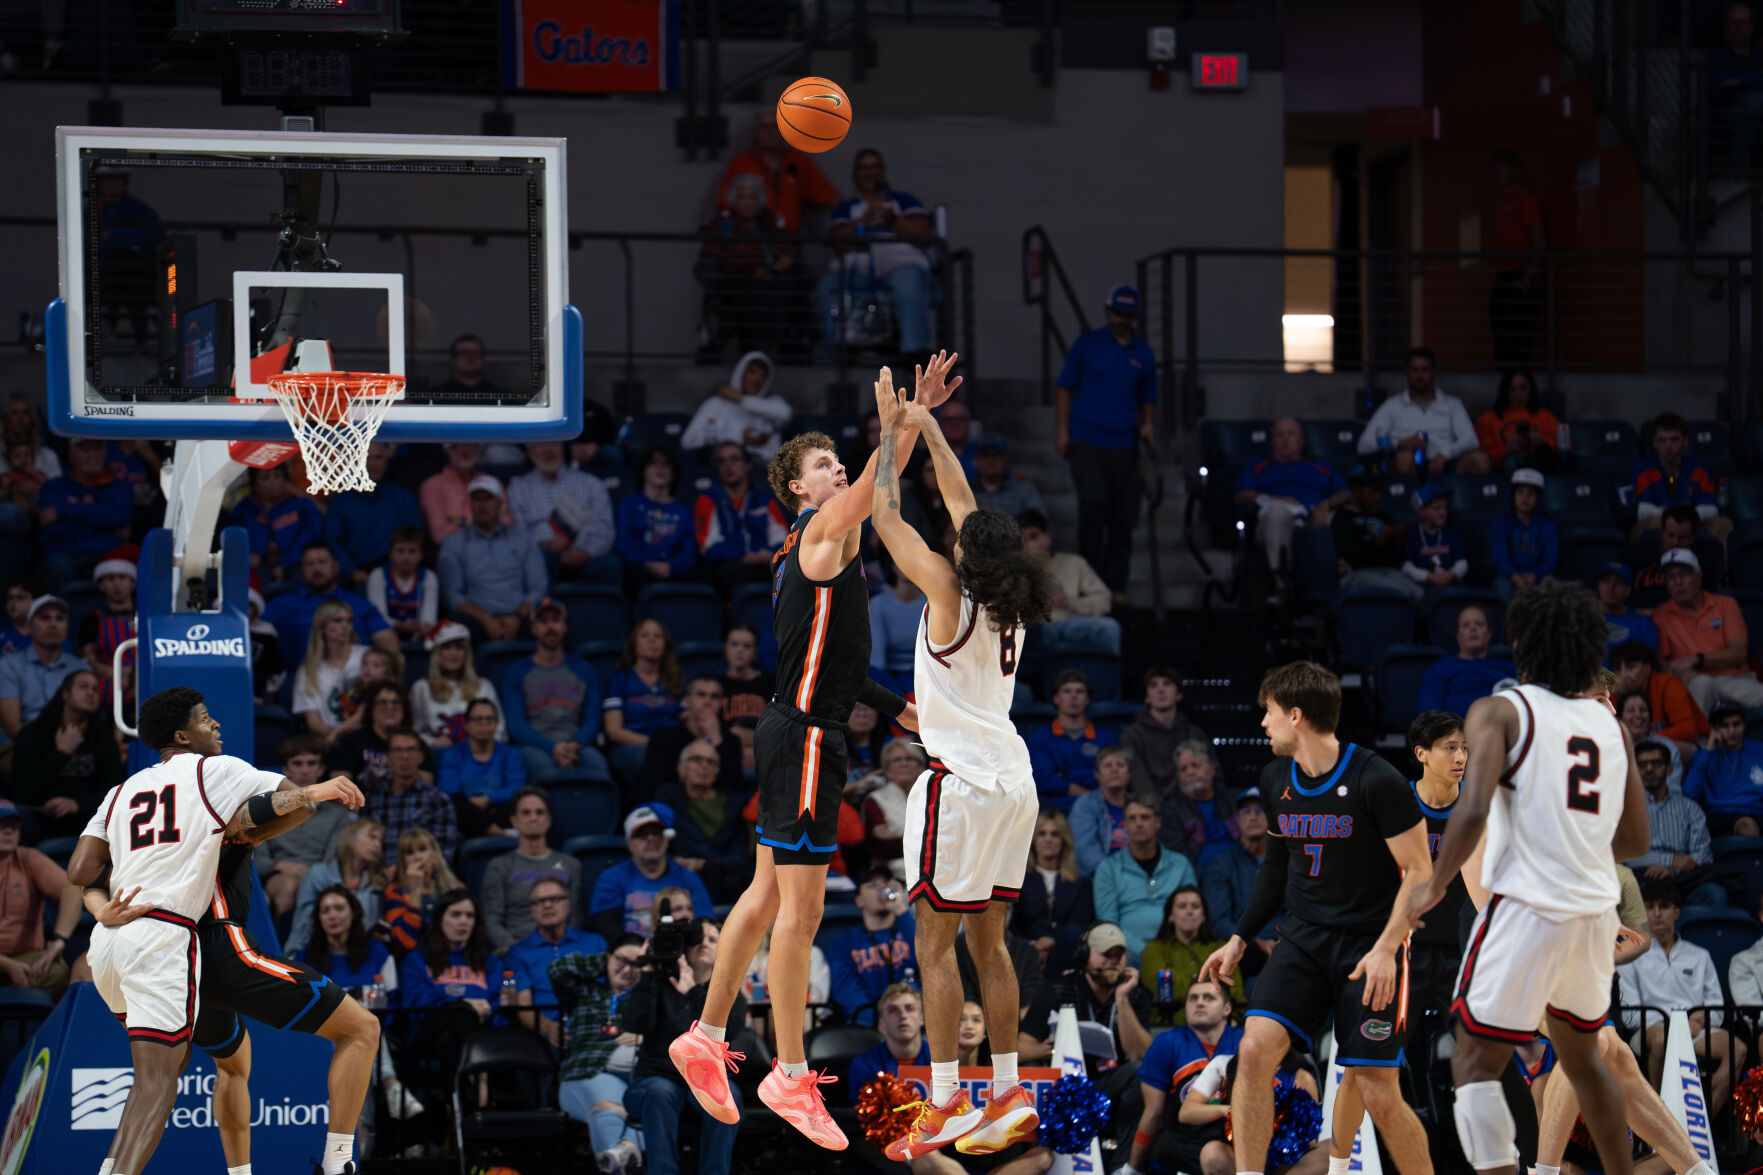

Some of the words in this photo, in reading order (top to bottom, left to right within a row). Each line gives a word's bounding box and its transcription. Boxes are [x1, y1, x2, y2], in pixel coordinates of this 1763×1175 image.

[532, 19, 652, 66] Gators
[1201, 55, 1239, 86] EXIT
[85, 406, 135, 417] SPALDING
[154, 637, 248, 658] SPALDING
[1000, 621, 1017, 677] 8
[1566, 735, 1600, 815] 2
[129, 783, 181, 851] 21
[1277, 814, 1353, 838] GATORS
[1304, 843, 1323, 878] 7
[1679, 1058, 1711, 1166] FLORID
